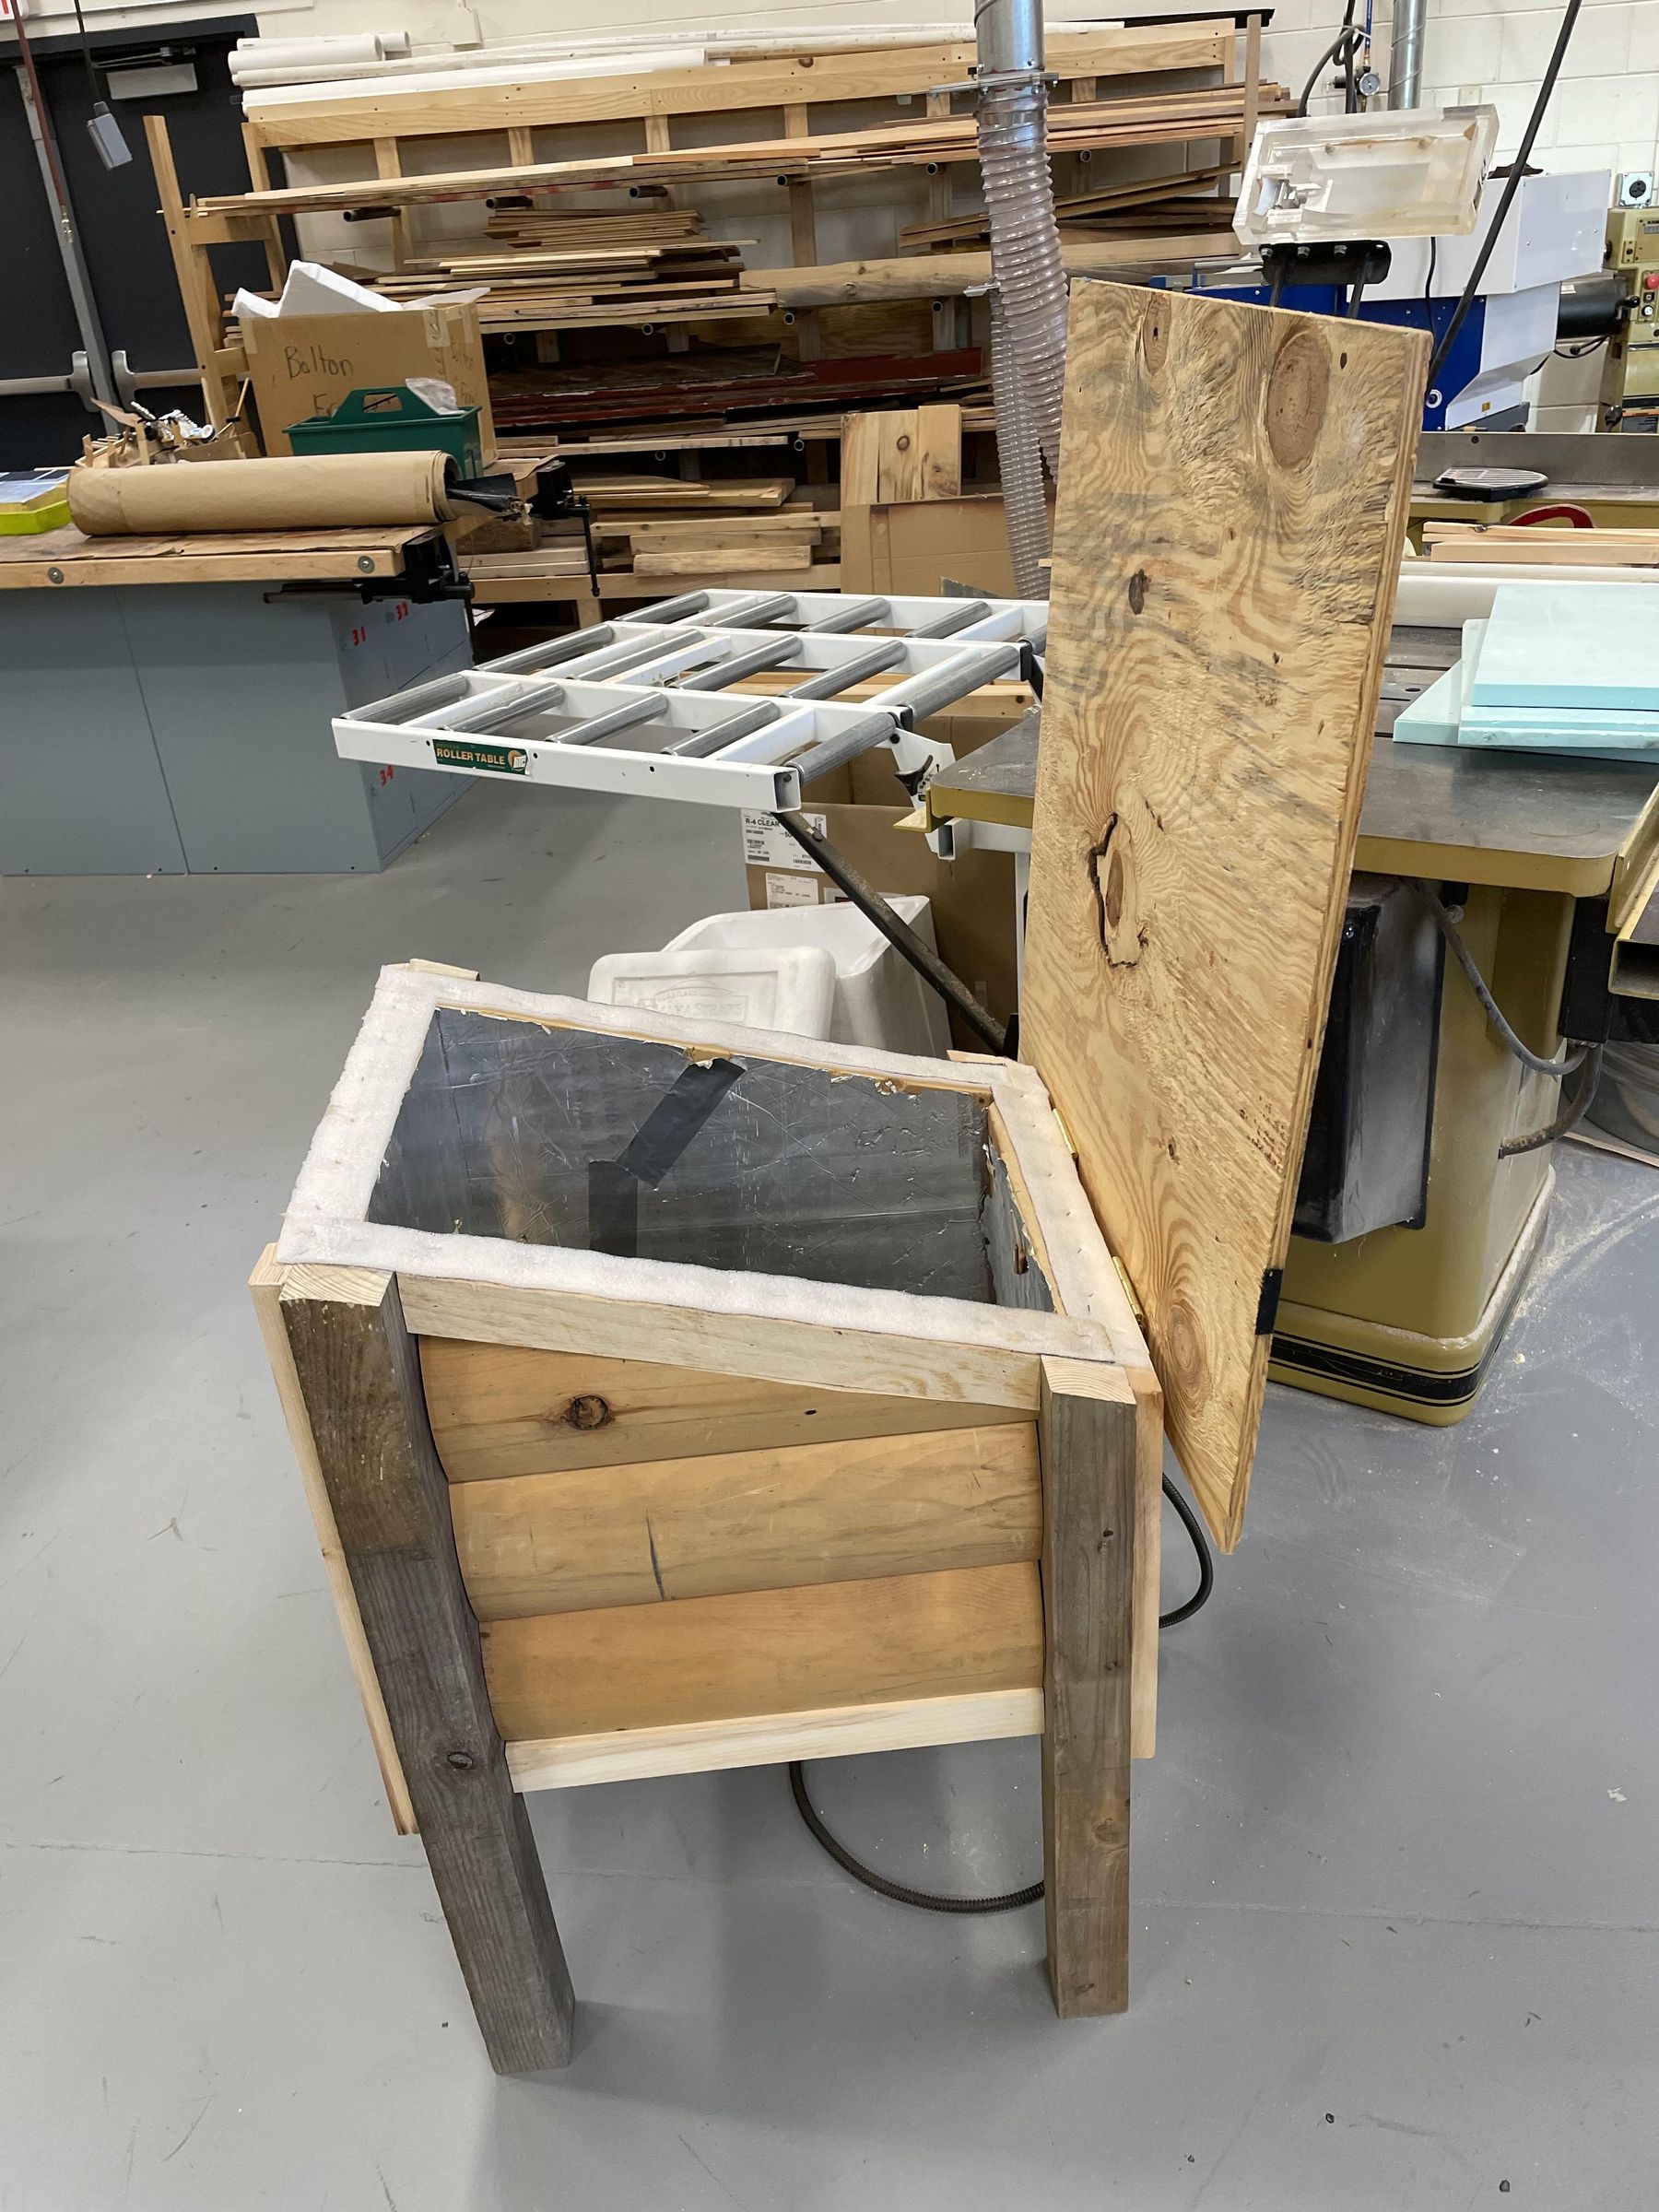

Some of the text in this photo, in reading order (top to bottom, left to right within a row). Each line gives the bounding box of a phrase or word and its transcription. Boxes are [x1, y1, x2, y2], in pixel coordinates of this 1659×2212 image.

[285, 345, 355, 381] Bolton
[352, 626, 366, 647] 31
[436, 747, 506, 766] ROLLER TABLE
[379, 764, 394, 786] 34
[757, 818, 781, 828] CLEAR
